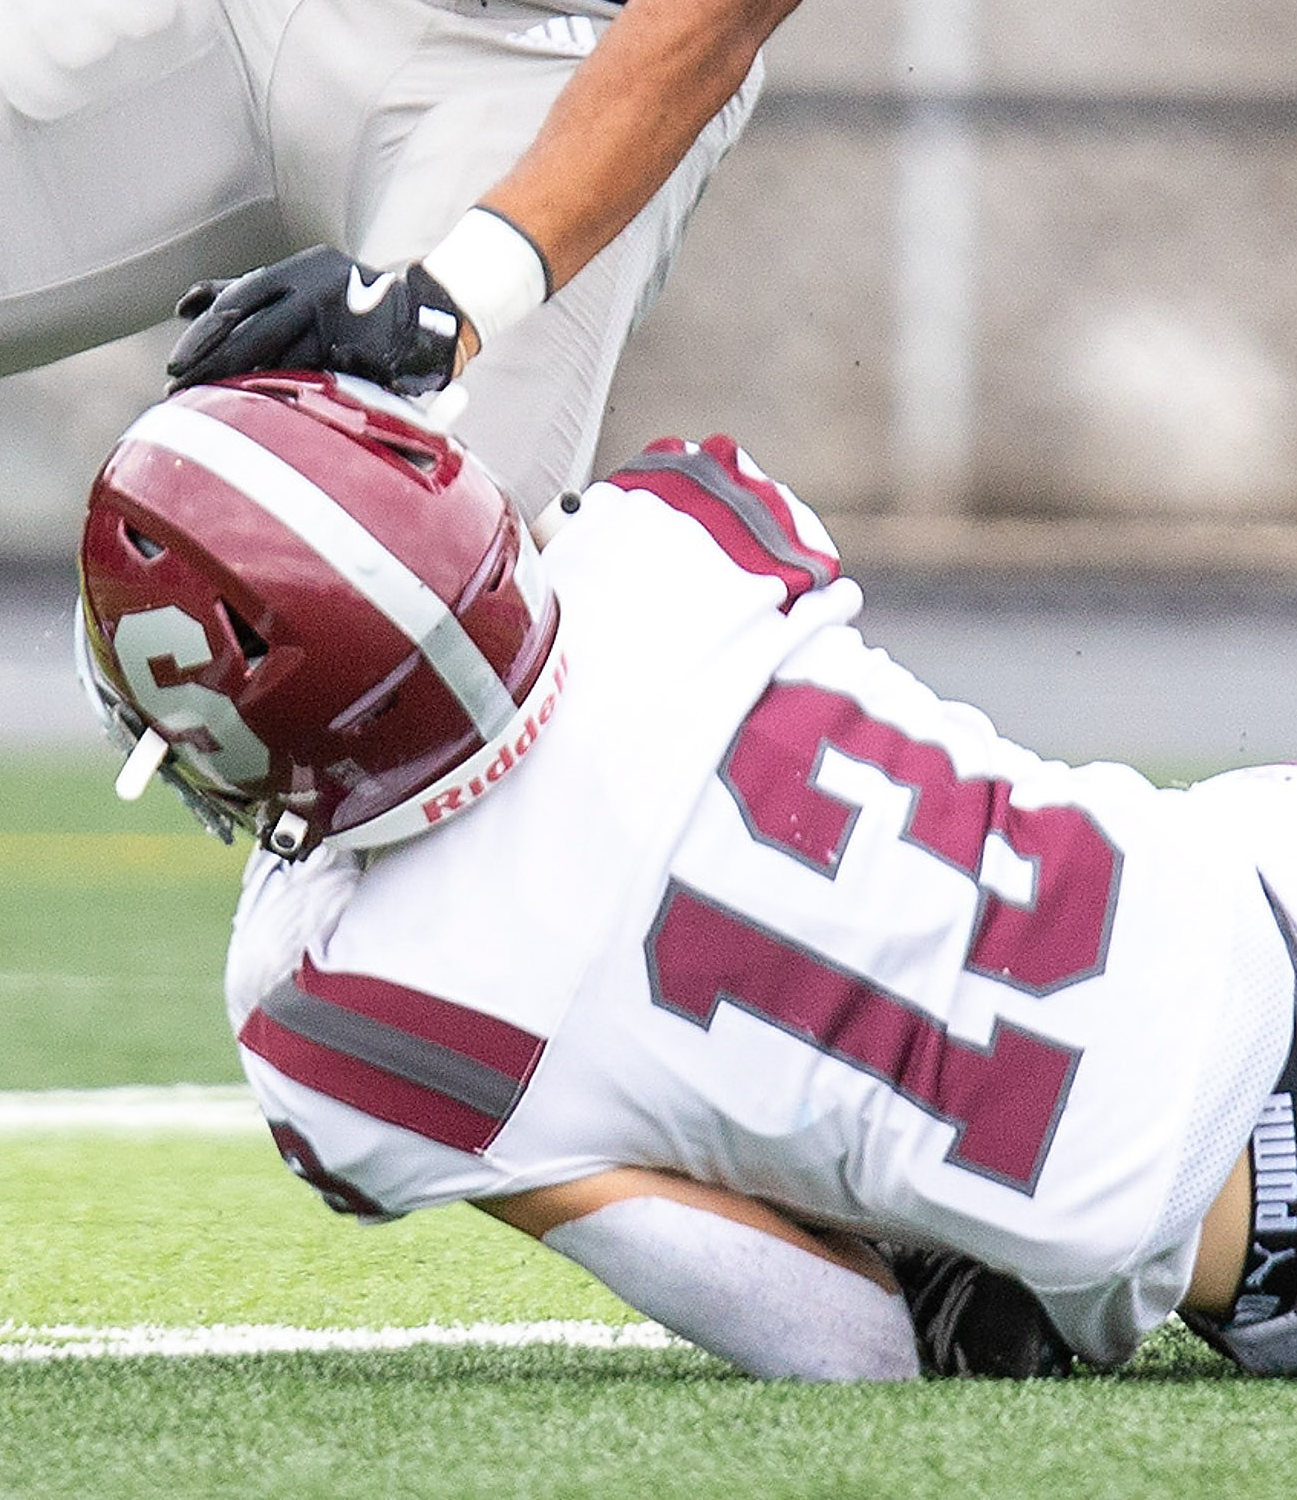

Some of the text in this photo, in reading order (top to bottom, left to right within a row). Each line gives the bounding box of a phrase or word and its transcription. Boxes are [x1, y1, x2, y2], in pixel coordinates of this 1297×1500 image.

[114, 605, 271, 787] S
[422, 652, 569, 824] Riddell
[643, 678, 1125, 1198] 13
